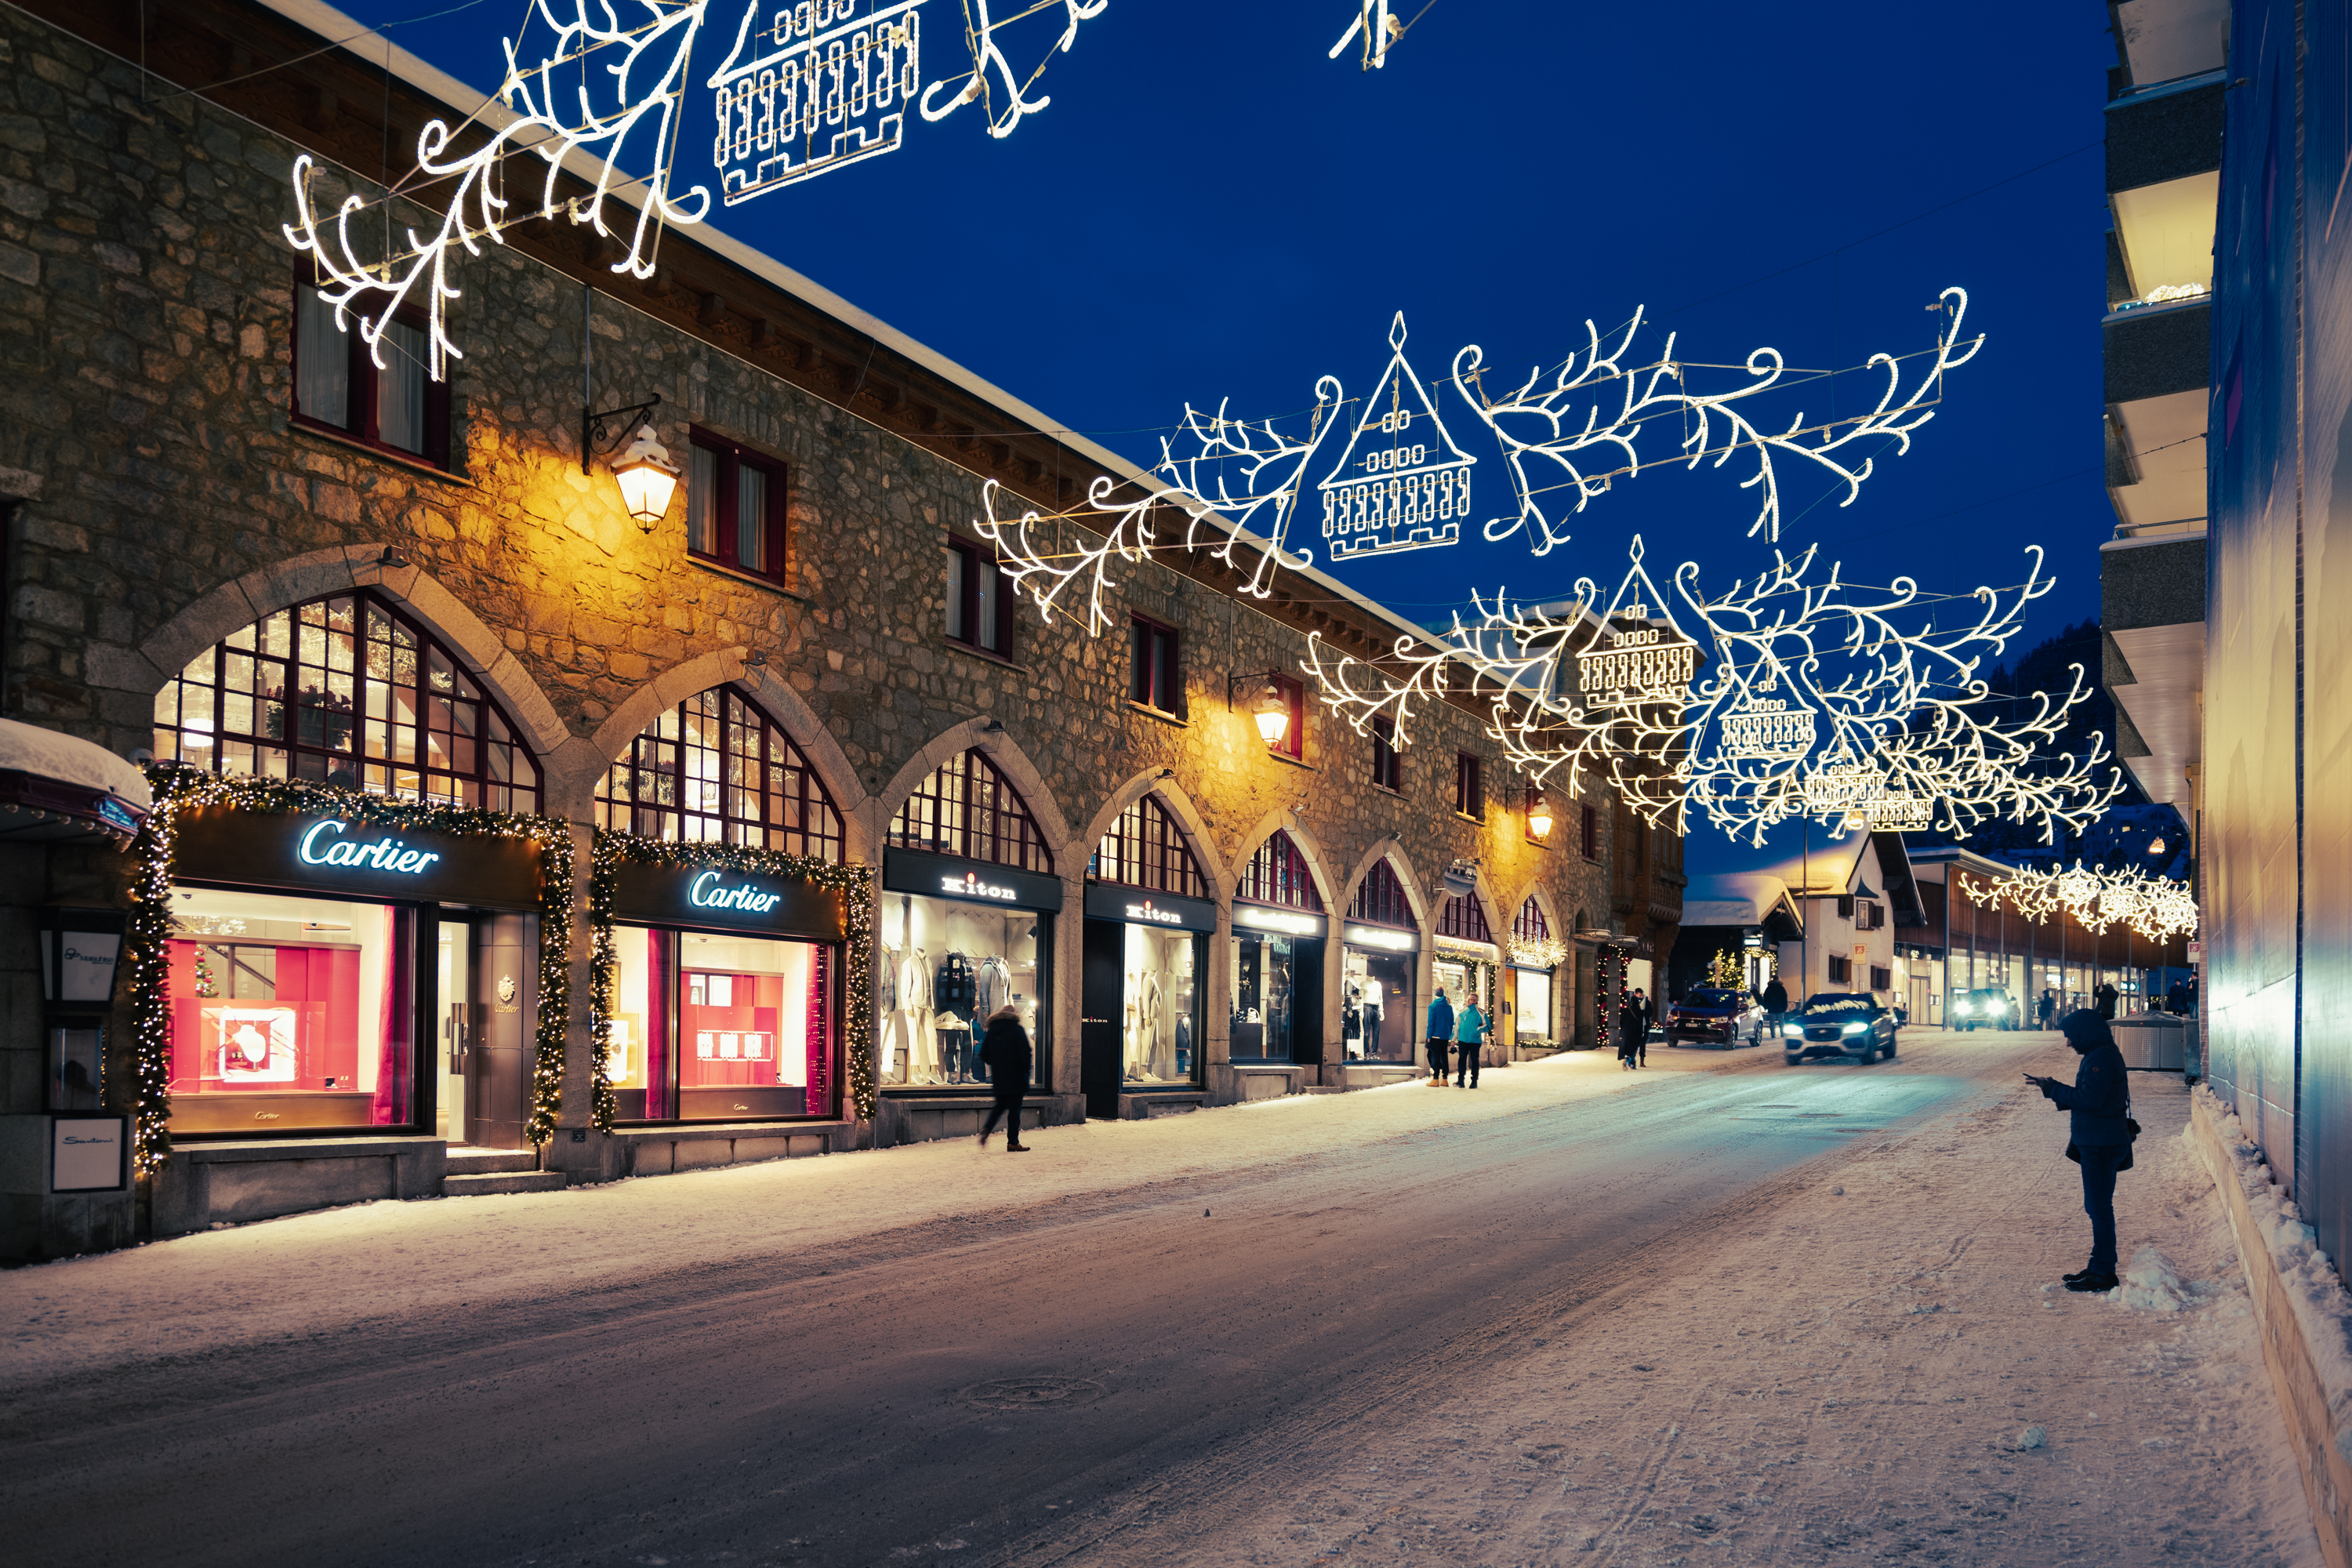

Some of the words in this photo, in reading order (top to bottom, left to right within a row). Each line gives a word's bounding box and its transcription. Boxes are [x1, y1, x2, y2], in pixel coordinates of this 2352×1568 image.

[301, 819, 439, 874] Cartier
[691, 871, 780, 913] Cartier
[942, 873, 1017, 900] Kiton
[1126, 902, 1182, 924] Kiton
[495, 1002, 520, 1014] Cartier
[255, 1111, 280, 1120] Cartier
[62, 1136, 114, 1145] Santoni
